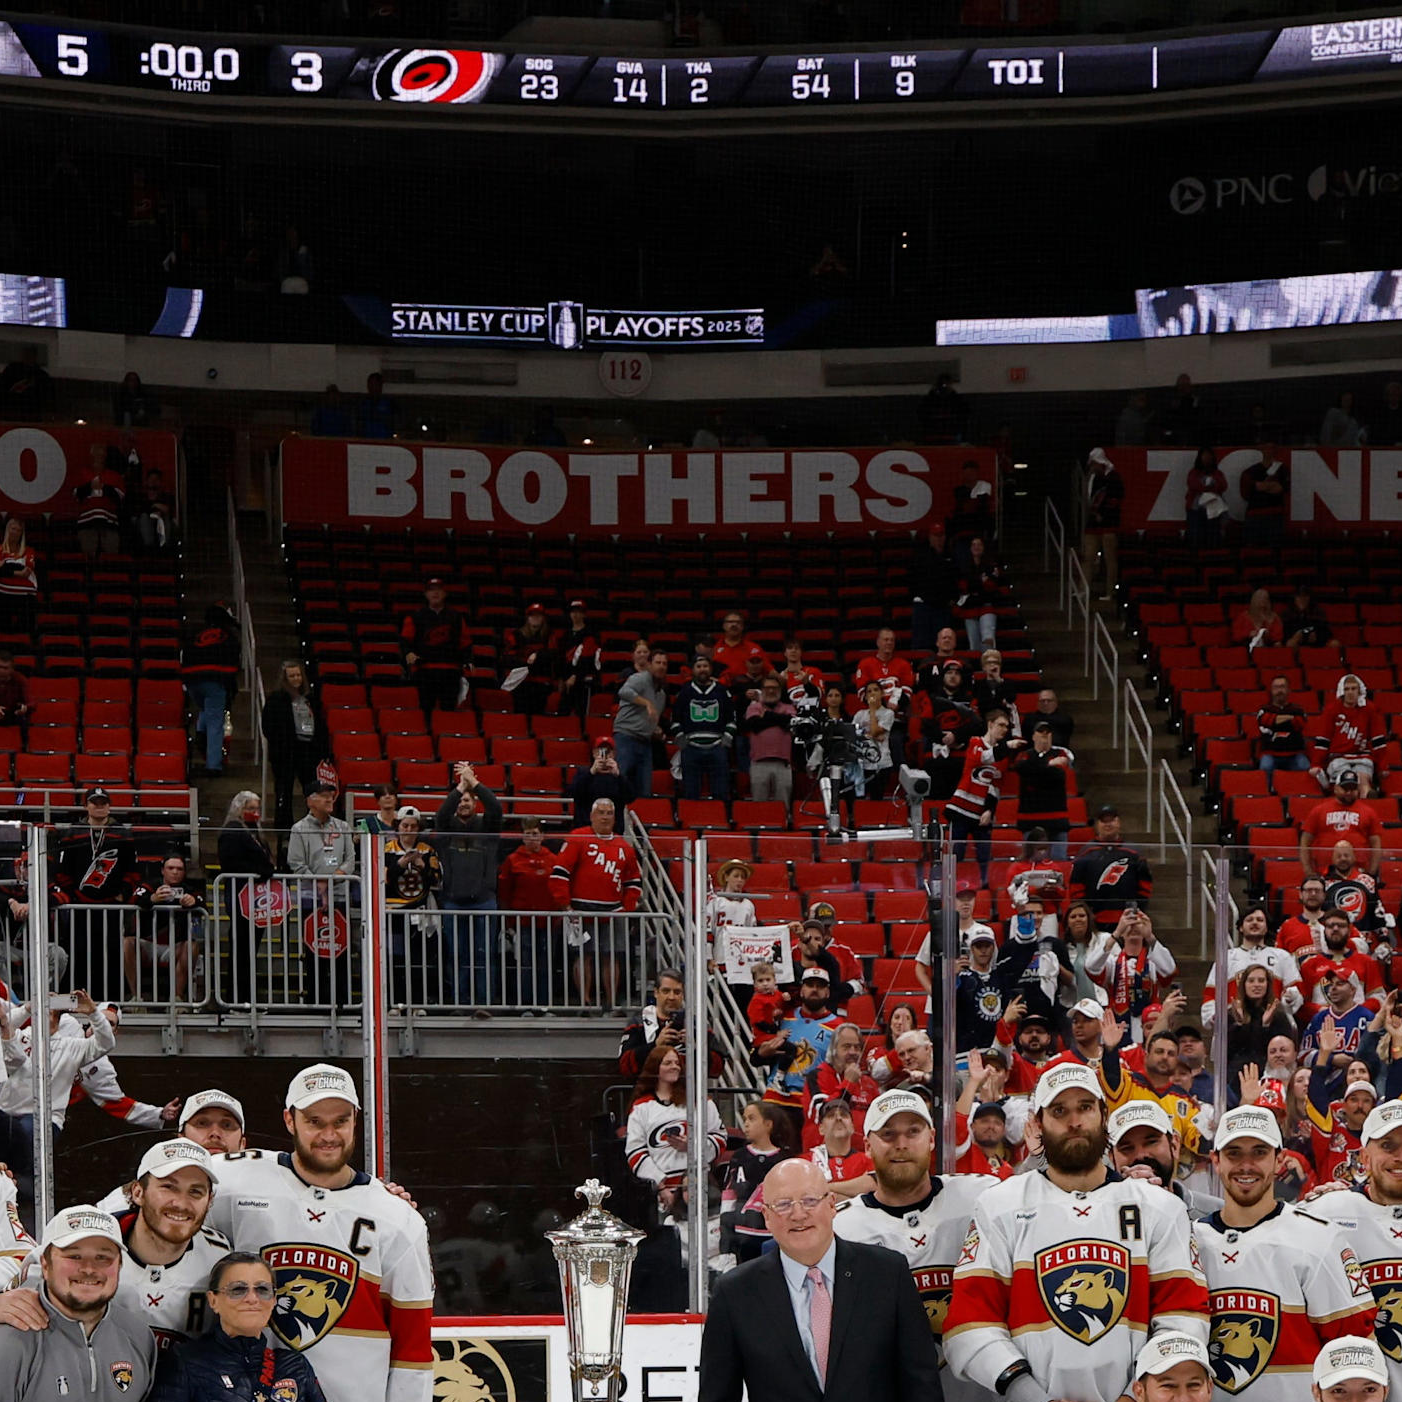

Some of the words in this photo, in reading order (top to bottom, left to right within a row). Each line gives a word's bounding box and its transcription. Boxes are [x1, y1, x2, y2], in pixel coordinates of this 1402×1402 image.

[57, 33, 88, 76] 5
[1311, 40, 1380, 56] CONFERENCE
[141, 42, 240, 81] :00.0
[290, 52, 323, 93] 3
[525, 58, 553, 71] SOG
[616, 61, 644, 75] GVA
[686, 62, 713, 74] TKA
[797, 58, 824, 70] SAT
[890, 55, 917, 68] BLK
[988, 59, 1044, 84] TOI
[169, 78, 211, 93] THIRD
[521, 74, 559, 100] 23
[613, 78, 648, 103] 14
[690, 78, 709, 103] 2
[792, 74, 831, 99] 54
[896, 71, 915, 96] 9
[1213, 173, 1294, 208] PNC
[391, 310, 495, 333] STANLEY
[500, 313, 545, 334] CUP
[586, 315, 705, 339] PLAYOFFS
[707, 320, 741, 333] 2025
[609, 359, 641, 381] 112
[346, 442, 933, 526] BROTHERS
[587, 843, 622, 893] CANES
[318, 1077, 346, 1090] CHAMPS
[1059, 1072, 1088, 1086] CHAMPS
[890, 1097, 917, 1110] CHAMPS
[1127, 1109, 1155, 1123] CHAMPS
[1239, 1116, 1268, 1130] CHAMPS
[238, 1200, 269, 1208] AutoNation
[83, 1217, 114, 1231] CHAMPS
[1119, 1204, 1141, 1240] A
[349, 1217, 376, 1256] C
[269, 1251, 349, 1276] FLORIDA
[1044, 1243, 1122, 1269] FLORIDA
[1215, 1293, 1271, 1314] ORIDA
[1343, 1352, 1375, 1366] CHAMPS
